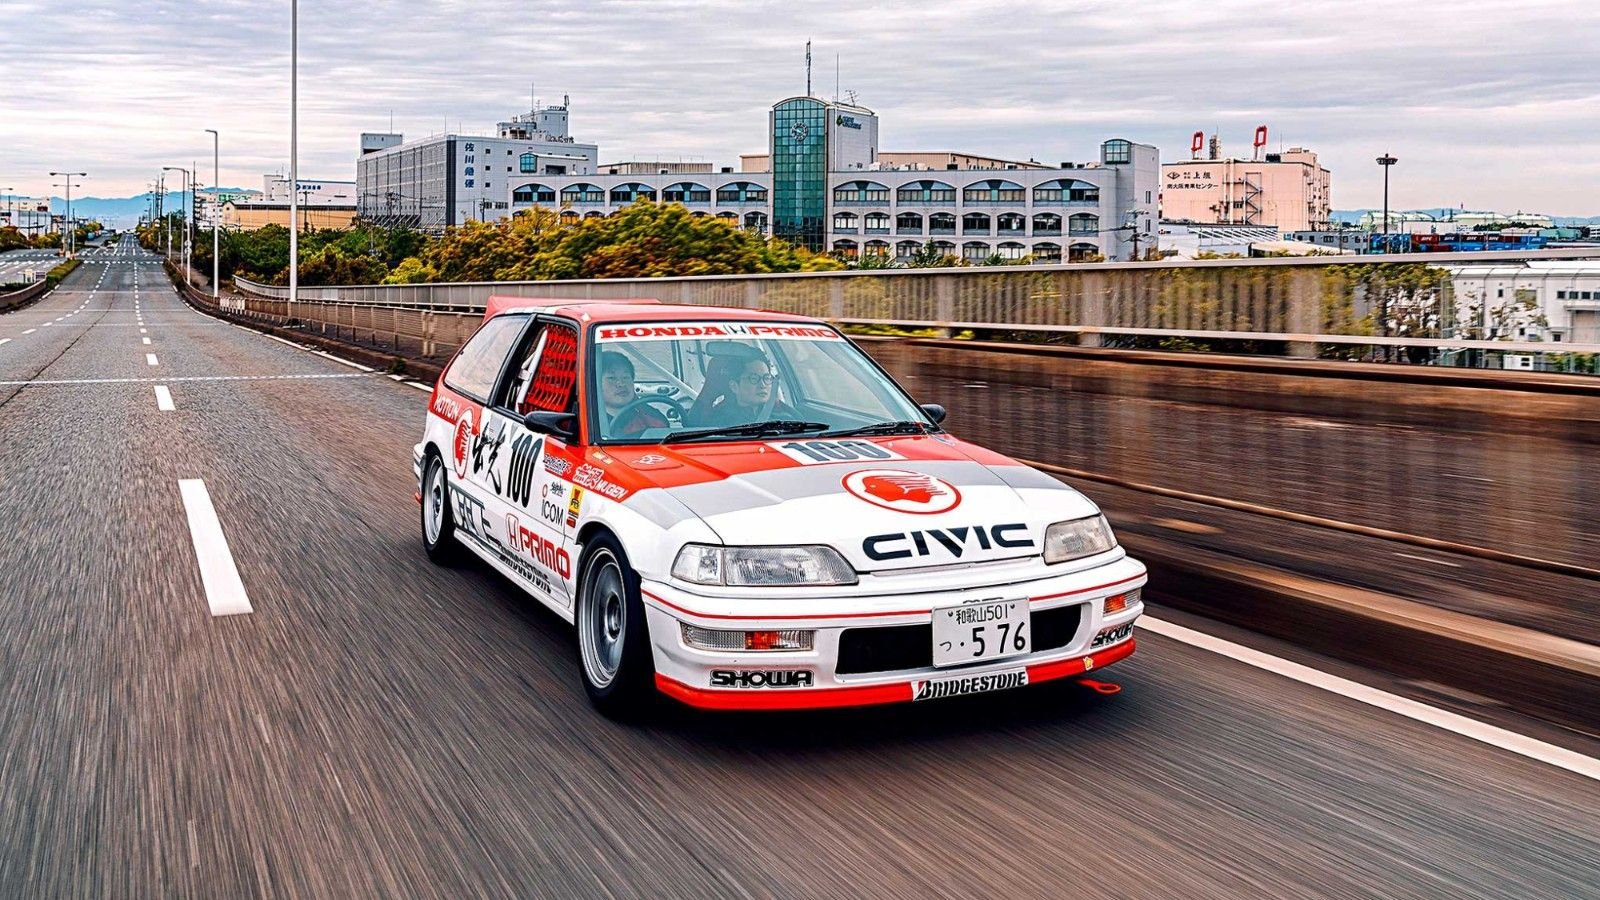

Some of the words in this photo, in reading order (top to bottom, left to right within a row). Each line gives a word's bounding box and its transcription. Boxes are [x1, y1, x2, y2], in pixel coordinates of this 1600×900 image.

[600, 326, 727, 339] HONDA
[750, 325, 839, 339] PRIMO
[782, 440, 892, 462] 100
[506, 432, 543, 509] 100
[596, 480, 628, 500] MUGEN
[519, 525, 571, 581] PRIMO
[862, 522, 1035, 562] CIVIC
[1090, 621, 1134, 649] SHOWA
[710, 669, 814, 688] SHOWA
[915, 674, 1026, 701] BRIDGESTONE
